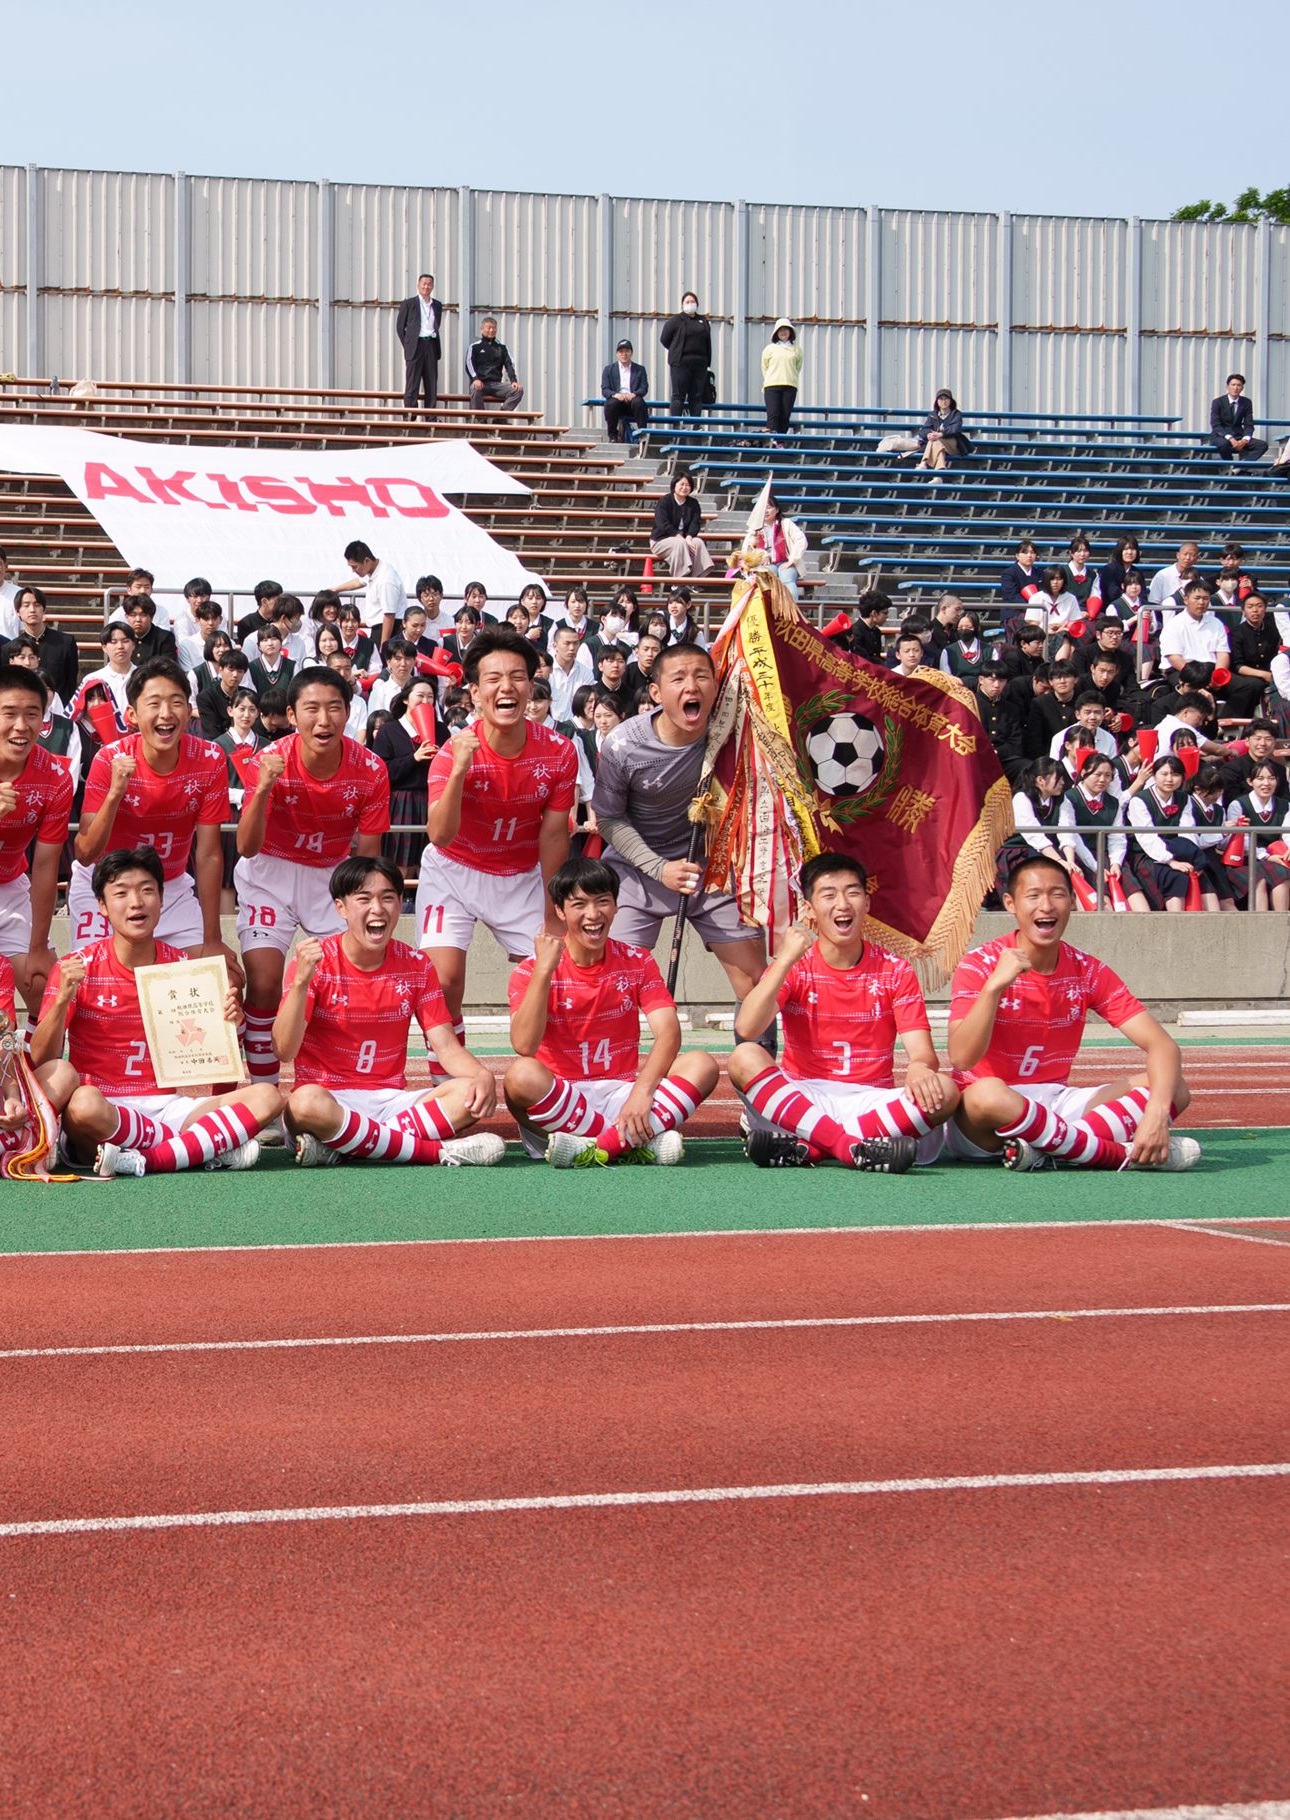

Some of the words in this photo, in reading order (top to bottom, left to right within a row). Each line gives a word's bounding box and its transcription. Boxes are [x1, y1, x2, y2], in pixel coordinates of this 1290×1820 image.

[85, 462, 451, 518] AKISHO
[774, 618, 977, 756] 秋田県高等学校総合体育大会
[295, 832, 325, 853] 18
[492, 817, 517, 840] 11
[77, 911, 110, 940] 23
[247, 904, 276, 927] 18
[423, 904, 444, 933] 11
[124, 1041, 146, 1075] 2
[356, 1040, 377, 1073] 8
[578, 1038, 612, 1075] 14
[832, 1041, 850, 1075] 3
[1018, 1045, 1044, 1076] 6
